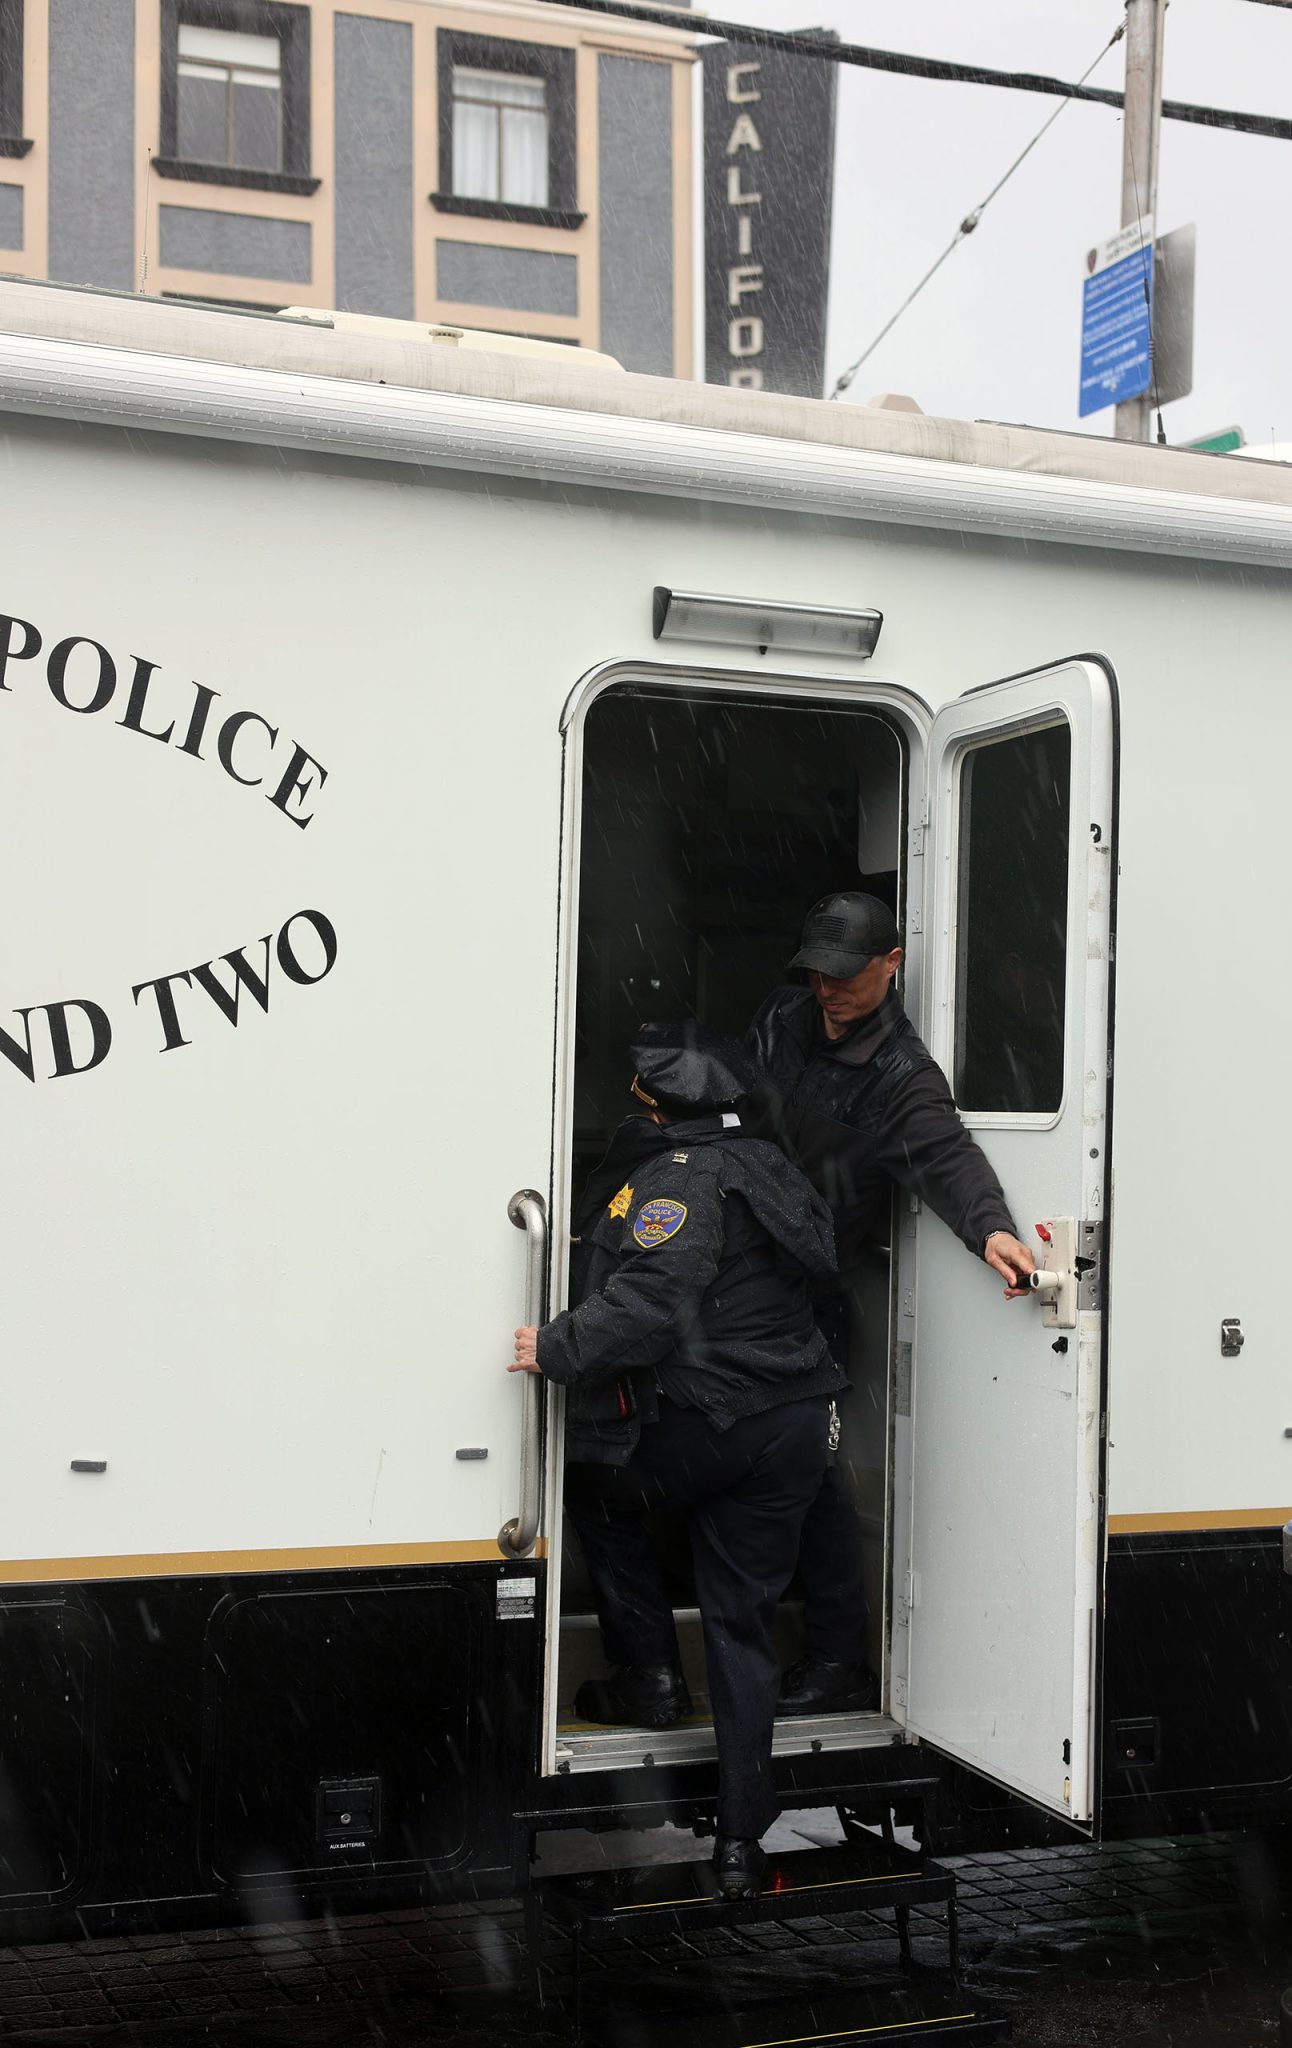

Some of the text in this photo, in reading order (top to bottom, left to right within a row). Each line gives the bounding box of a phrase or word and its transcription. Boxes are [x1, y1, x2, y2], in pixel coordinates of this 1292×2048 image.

[0, 613, 329, 830] POLICE
[131, 909, 338, 1053] TWO
[653, 1201, 684, 1214] FRANCISCO
